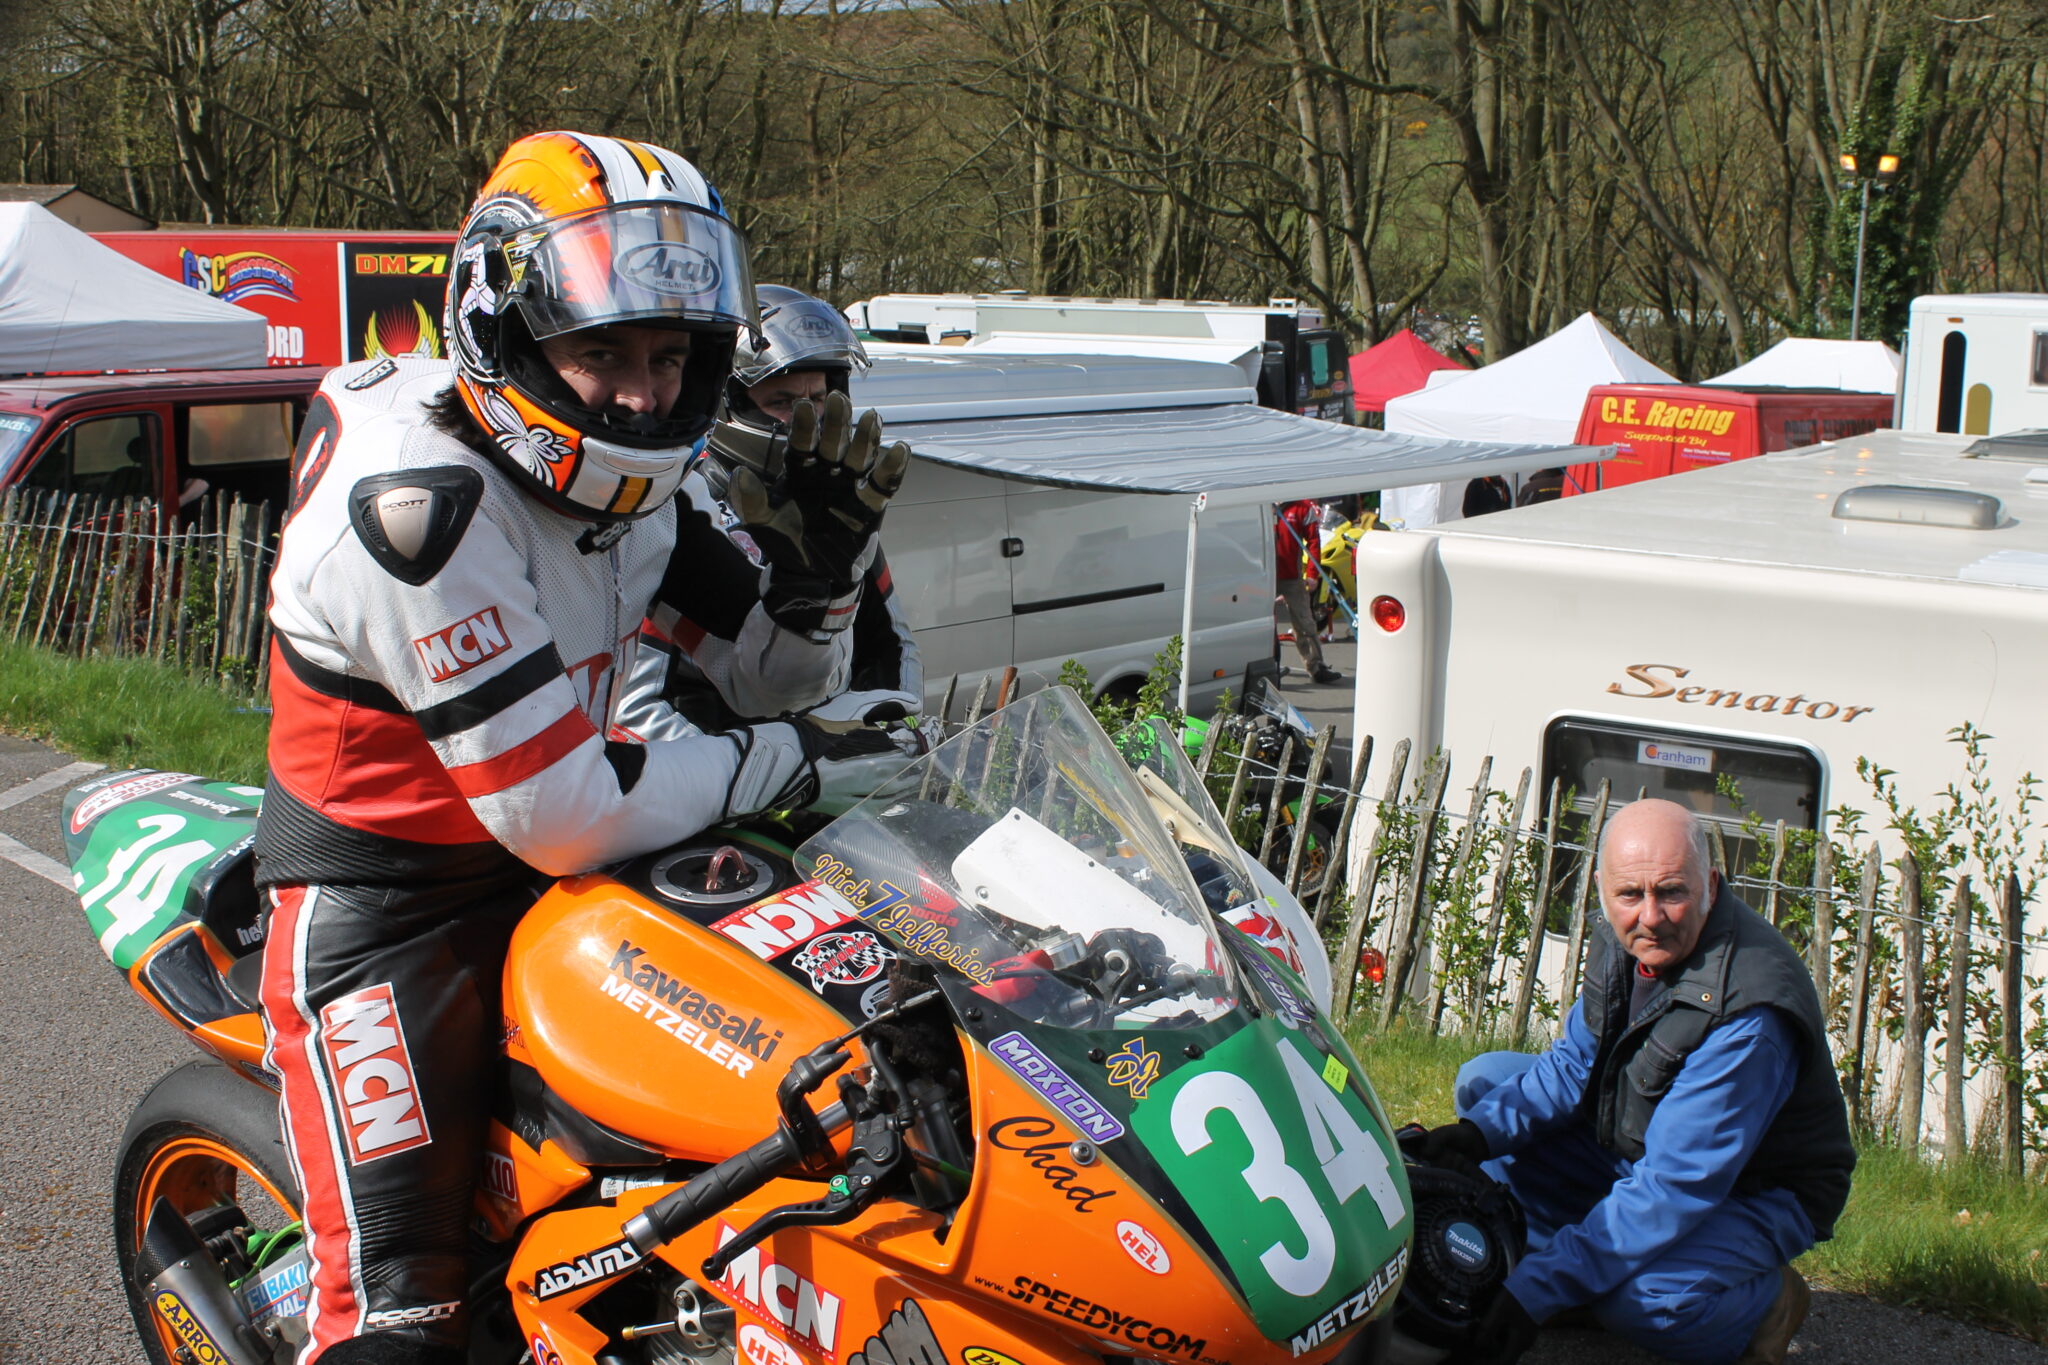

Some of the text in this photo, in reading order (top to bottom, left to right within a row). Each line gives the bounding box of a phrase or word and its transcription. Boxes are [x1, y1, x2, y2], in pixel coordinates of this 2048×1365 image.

[624, 247, 714, 283] Arai
[1601, 396, 1736, 436] C.E. Racing
[1624, 430, 1708, 447] Supported By
[381, 499, 428, 510] SCOTT
[417, 610, 507, 679] MCN
[1606, 663, 1874, 723] Senator
[1645, 744, 1706, 765] Cranham
[720, 882, 859, 962] MCN
[811, 853, 871, 907] Nick
[877, 903, 995, 988] Jefferies
[599, 974, 755, 1079] METZELER
[607, 939, 785, 1063] Kawasaki
[329, 997, 423, 1154] MCN
[997, 1038, 1117, 1137] MAXTON
[987, 1116, 1117, 1214] Chad
[1169, 1036, 1407, 1297] 34
[539, 1241, 642, 1298] ADAMS
[1120, 1229, 1160, 1271] HEL
[1448, 1228, 1484, 1257] makita
[365, 1300, 461, 1325] SCOTT
[718, 1224, 840, 1353] MCN
[1290, 1247, 1409, 1358] METZELER
